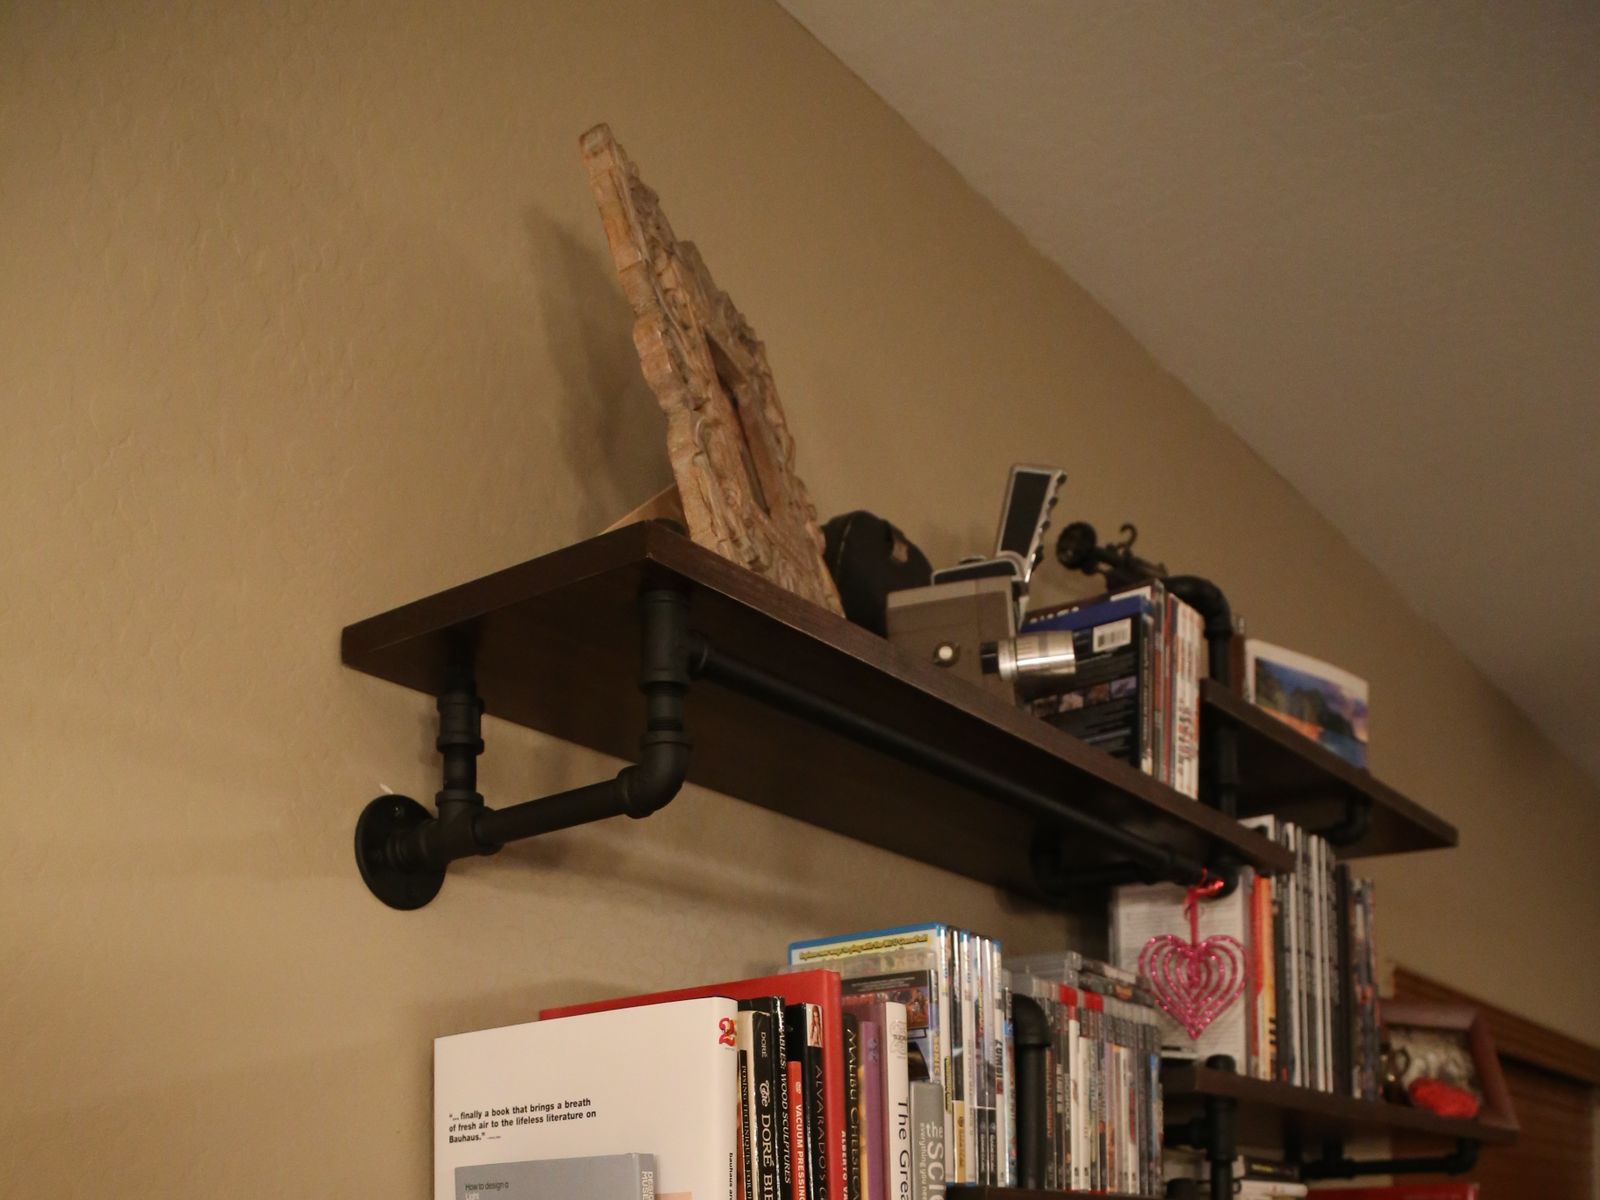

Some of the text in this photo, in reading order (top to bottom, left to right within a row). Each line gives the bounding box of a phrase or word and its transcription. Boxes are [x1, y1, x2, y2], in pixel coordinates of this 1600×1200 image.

[846, 1028, 859, 1100] MALIBU
[460, 1110, 482, 1120] finally
[491, 1108, 510, 1116] book
[512, 1105, 528, 1114] that
[530, 1102, 555, 1112] brings
[564, 1098, 591, 1109] breath
[759, 1080, 770, 1108] The
[780, 1073, 790, 1110] WOOD
[449, 1110, 596, 1132] of fresh air to the lifeless literature on
[449, 1132, 485, 1144] Bauhaus."
[795, 1103, 804, 1149] VACUUM
[815, 1064, 829, 1181] ALVARADO'S
[898, 1100, 911, 1140] The
[926, 1121, 943, 1139] the
[761, 1114, 774, 1168] DORÉ
[781, 1111, 793, 1184] SCULPTURES
[840, 1130, 848, 1182] ALBERTO
[918, 1122, 929, 1167] everything
[465, 1183, 478, 1191] How
[484, 1181, 504, 1191] design
[745, 1169, 753, 1188] FOR
[920, 1168, 929, 1184] you
